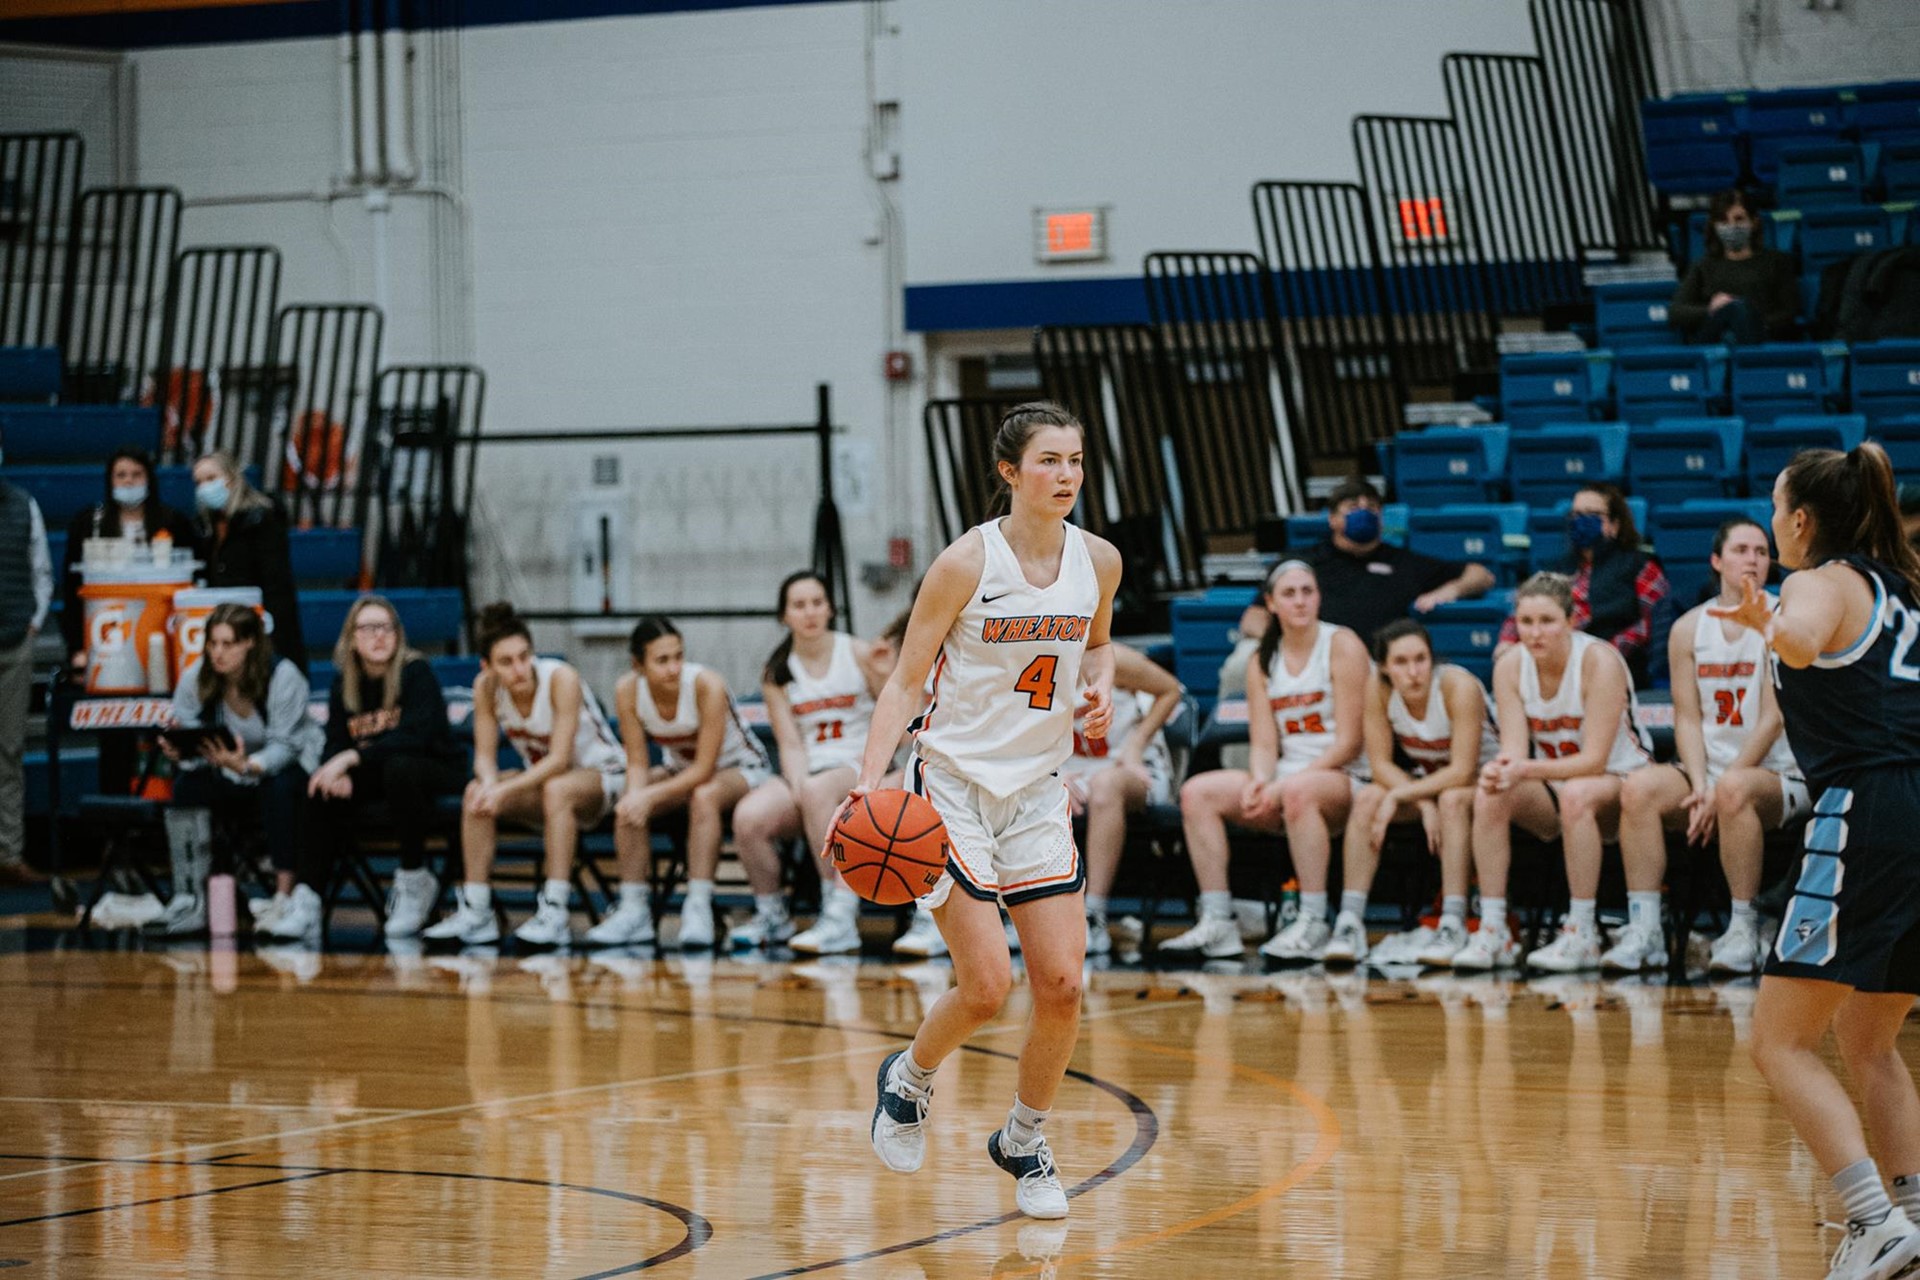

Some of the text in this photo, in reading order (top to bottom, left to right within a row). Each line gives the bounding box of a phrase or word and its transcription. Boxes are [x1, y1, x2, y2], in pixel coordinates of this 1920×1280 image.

[981, 615, 1091, 643] WHEATON
[1884, 594, 1920, 681] 2
[1014, 654, 1059, 711] 4
[1714, 687, 1747, 726] 31
